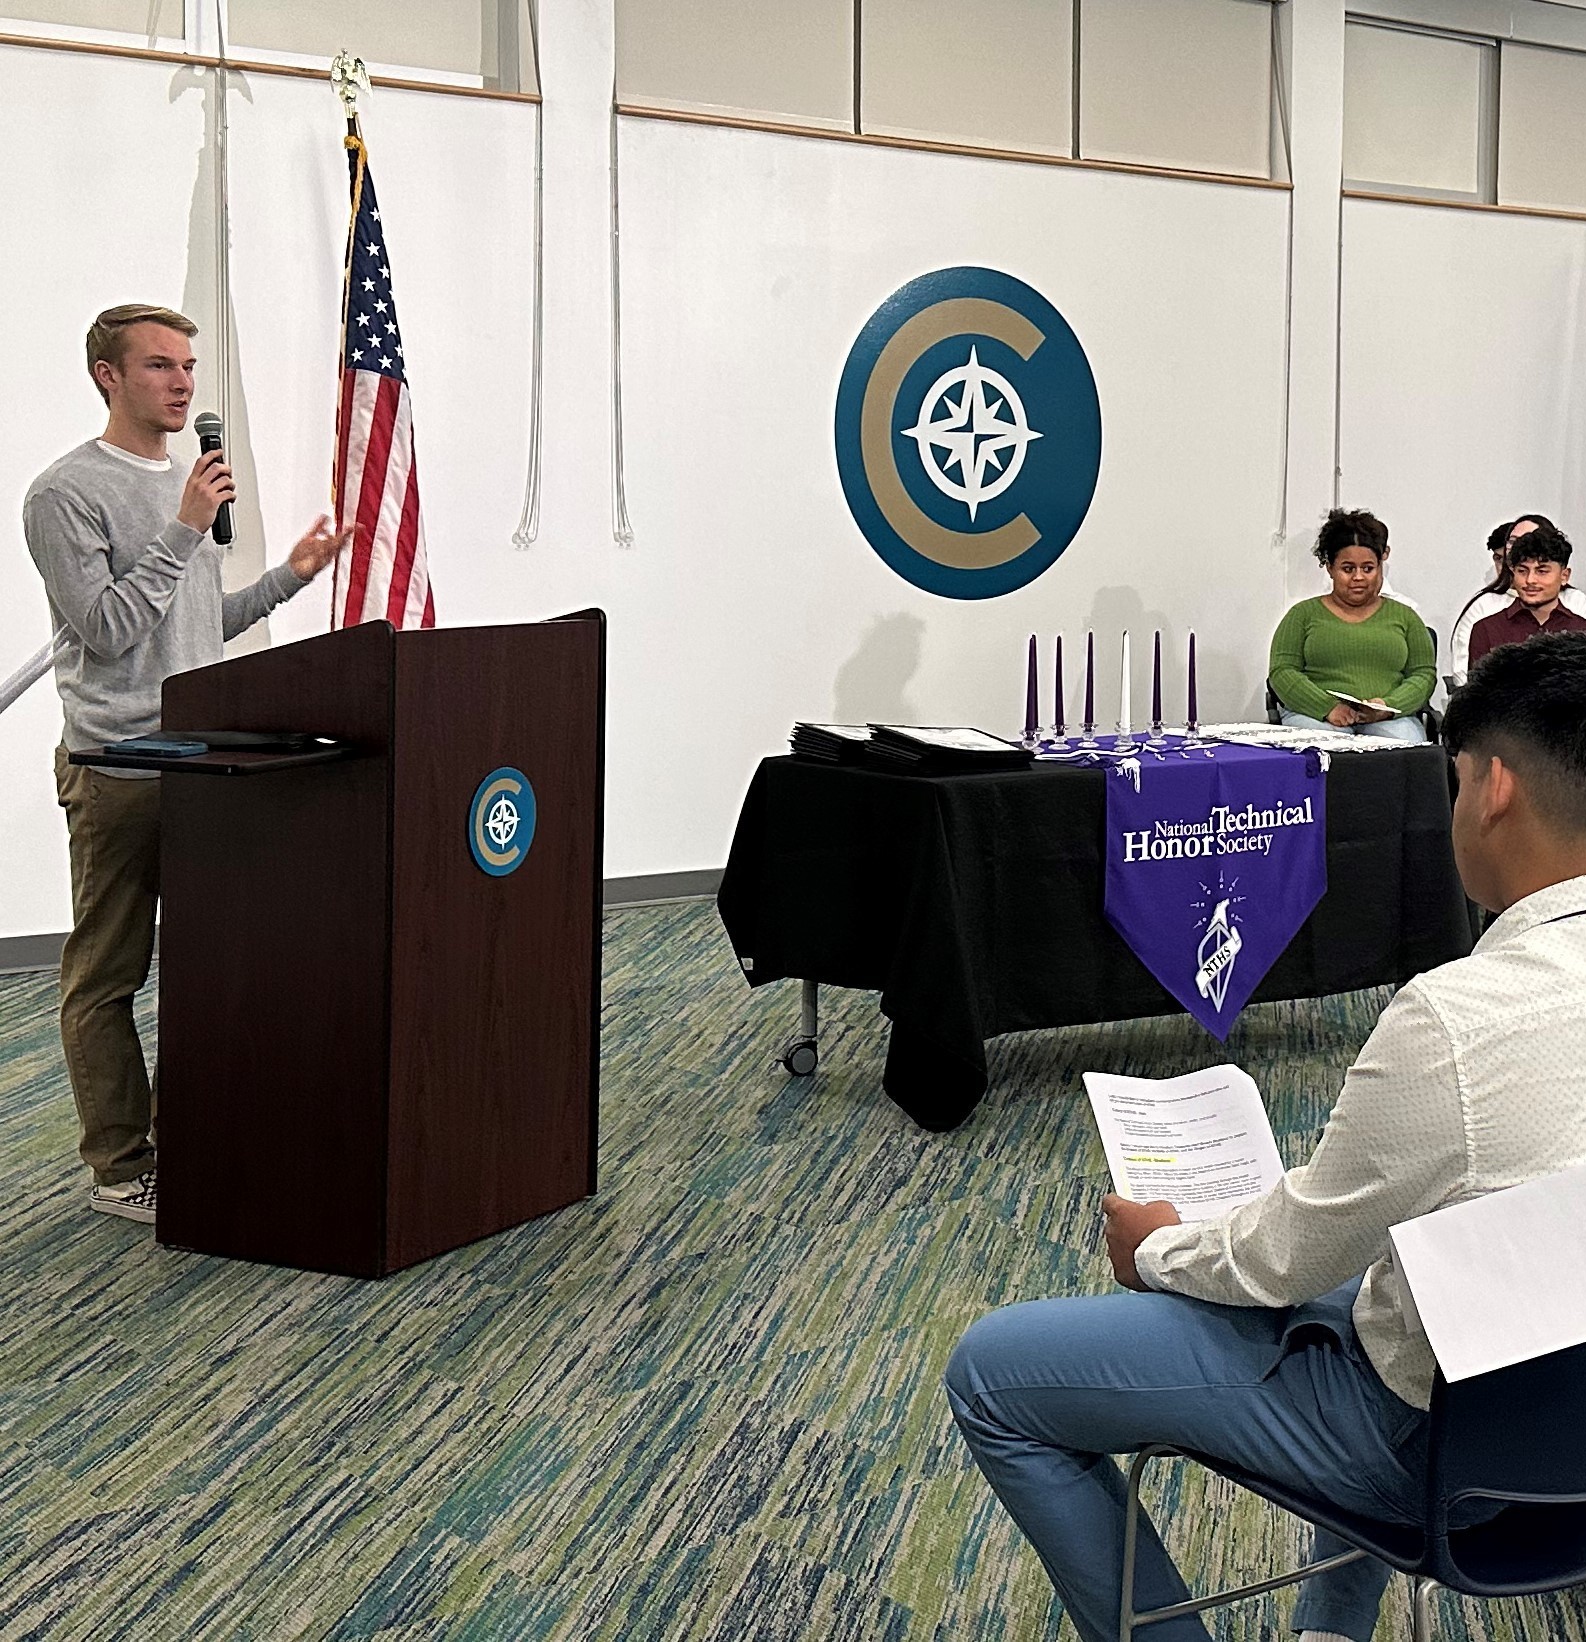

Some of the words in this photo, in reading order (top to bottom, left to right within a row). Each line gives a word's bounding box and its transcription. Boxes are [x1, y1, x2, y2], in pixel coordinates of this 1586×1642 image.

[1155, 816, 1214, 838] National
[1211, 796, 1314, 834] Technical
[1123, 830, 1215, 863] Honor
[1216, 832, 1274, 856] Society
[1202, 945, 1232, 978] NTHS
